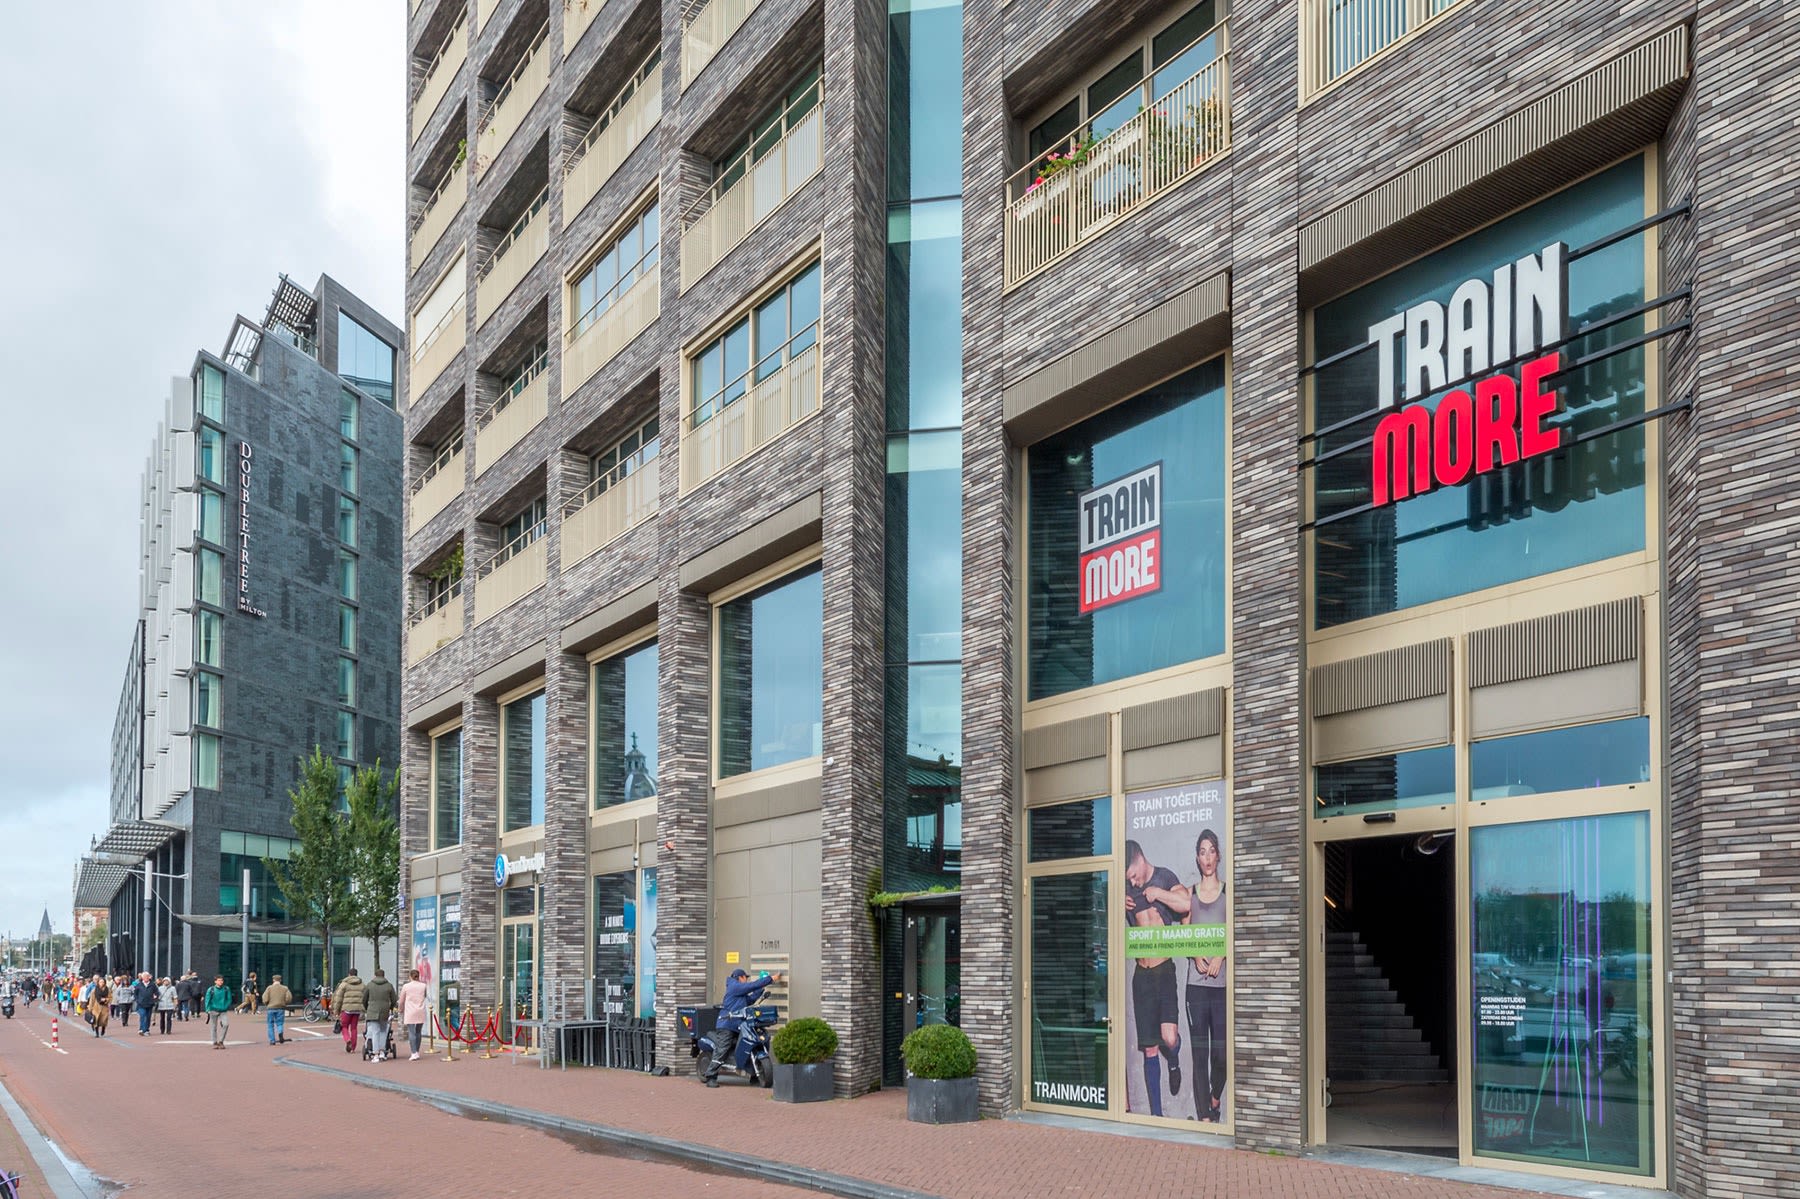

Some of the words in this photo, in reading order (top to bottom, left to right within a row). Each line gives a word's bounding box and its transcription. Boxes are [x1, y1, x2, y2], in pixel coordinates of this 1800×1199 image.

[1367, 241, 1568, 411] TRAIN
[1372, 352, 1563, 507] MORE
[240, 441, 252, 593] DOUBLETREE
[1083, 473, 1157, 542] TRAIN
[1083, 538, 1157, 605] MORE
[240, 597, 250, 605] BY
[240, 604, 267, 617] HILTON
[1133, 798, 1163, 812] TRAIN
[1164, 789, 1221, 808] TOGETHER,
[1133, 814, 1157, 829] STAY
[1159, 808, 1213, 826] TOGETHER
[1128, 930, 1154, 940] SPORT
[1155, 930, 1160, 940] 1
[1162, 929, 1193, 940] MAAND
[1194, 927, 1226, 938] GRATIS
[1480, 996, 1527, 1004] OPENINGSTIJDEN
[1034, 1081, 1106, 1104] TRAINMORE
